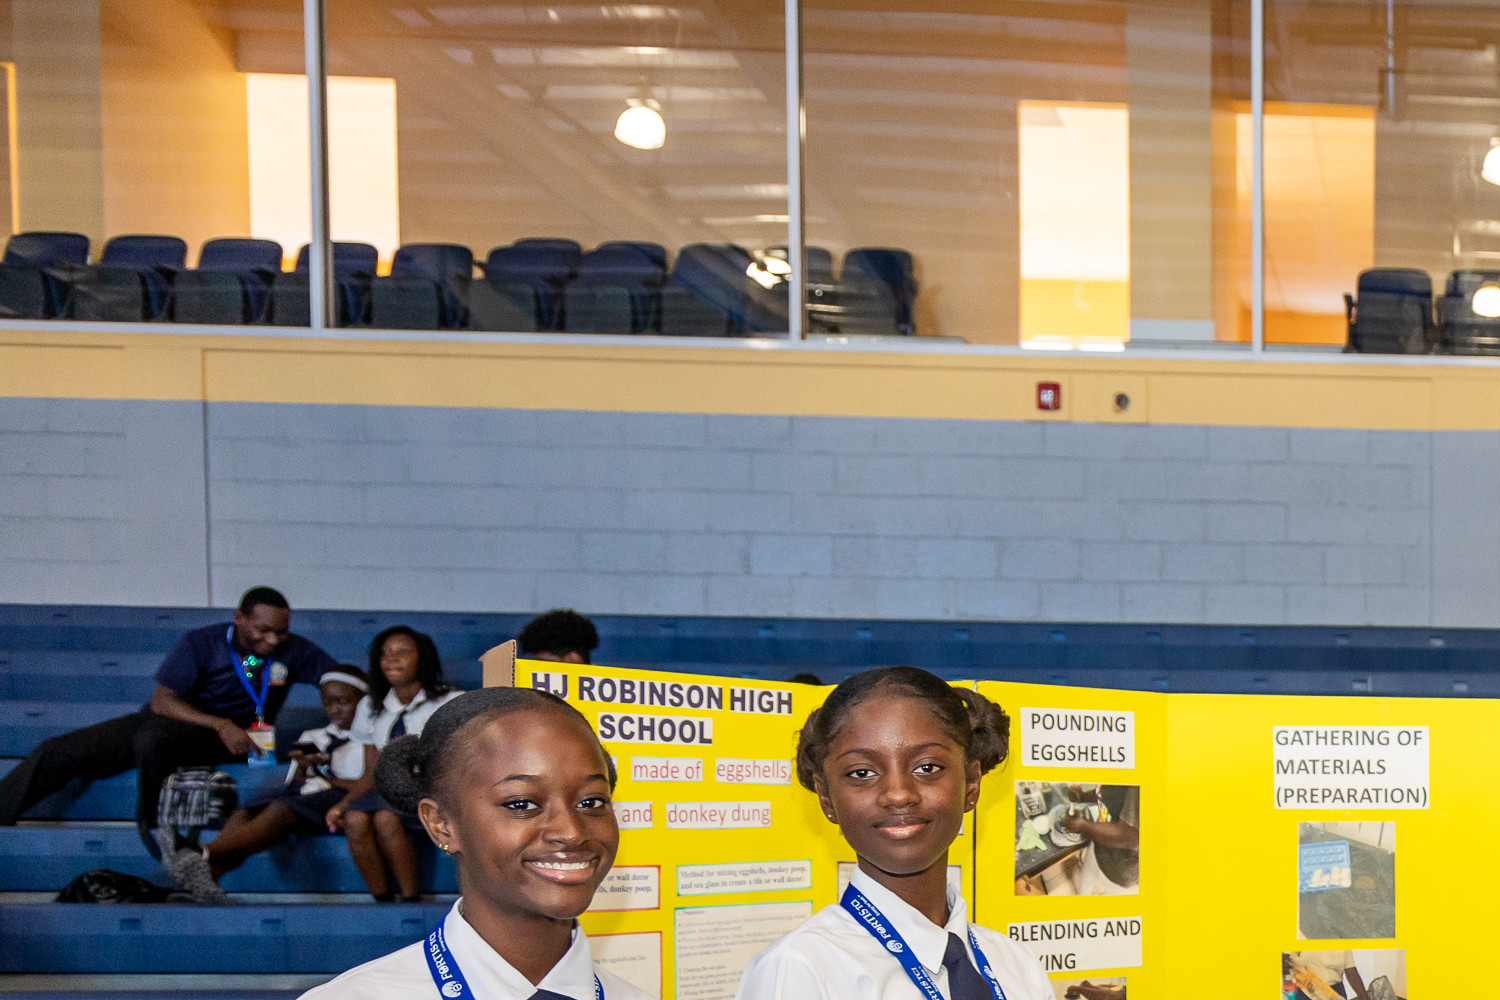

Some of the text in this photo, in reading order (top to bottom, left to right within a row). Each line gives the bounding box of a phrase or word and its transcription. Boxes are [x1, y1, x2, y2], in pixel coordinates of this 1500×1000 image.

[579, 676, 723, 710] ROBINSON
[730, 688, 792, 714] HIGH
[600, 715, 712, 744] SCHOOL
[1031, 713, 1126, 733] POUNDING
[1276, 730, 1422, 746] GATHERING OF
[1031, 744, 1126, 762] EGGSHELLS
[633, 761, 679, 778] made
[685, 761, 702, 779] of
[1276, 759, 1386, 774] MATERIALS
[1277, 787, 1427, 807] (PREPARATION)
[622, 805, 770, 825] and donkey dung
[1009, 920, 1141, 942] BLENDING AND
